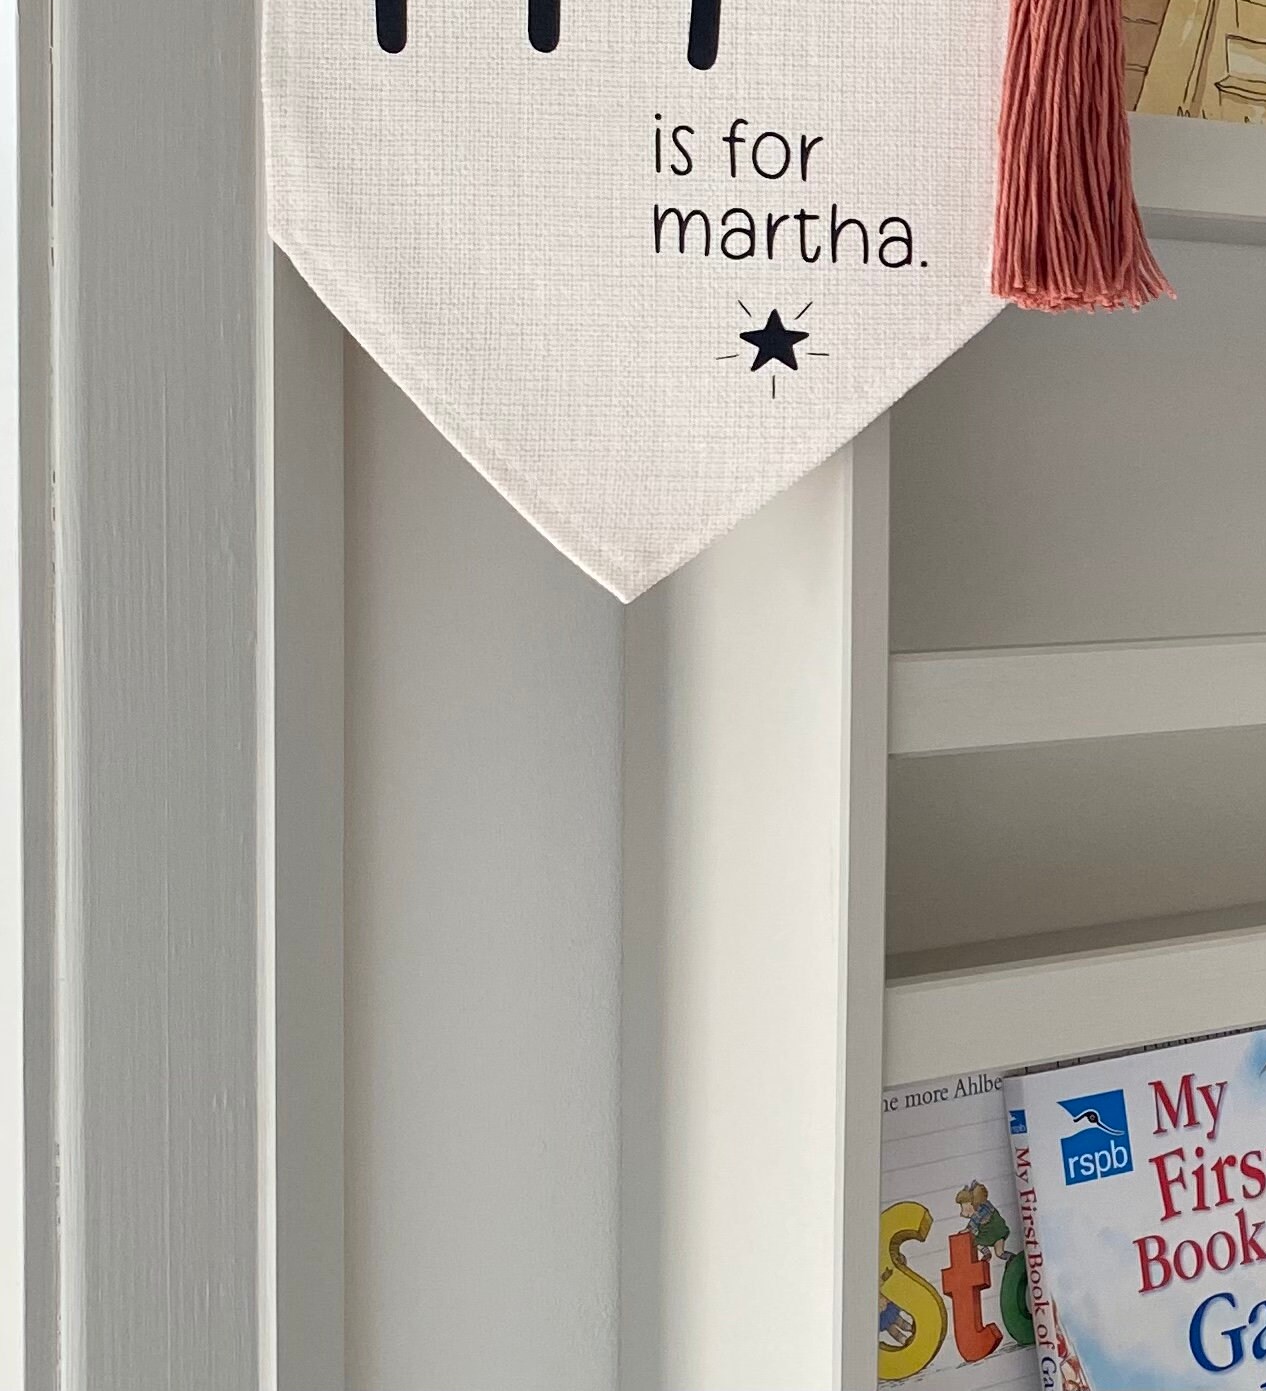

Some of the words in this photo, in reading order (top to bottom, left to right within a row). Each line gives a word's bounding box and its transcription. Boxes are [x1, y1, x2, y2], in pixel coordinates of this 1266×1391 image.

[653, 113, 695, 177] is
[722, 118, 824, 183] for
[653, 203, 929, 268] martha.
[905, 1087, 949, 1108] more
[954, 1073, 1003, 1100] Ahlbe
[1148, 1073, 1228, 1140] My
[1015, 1146, 1032, 1183] My
[1068, 1139, 1128, 1180] rspb
[1020, 1186, 1039, 1248] First
[1028, 1251, 1050, 1318] Book
[1037, 1324, 1056, 1351] of
